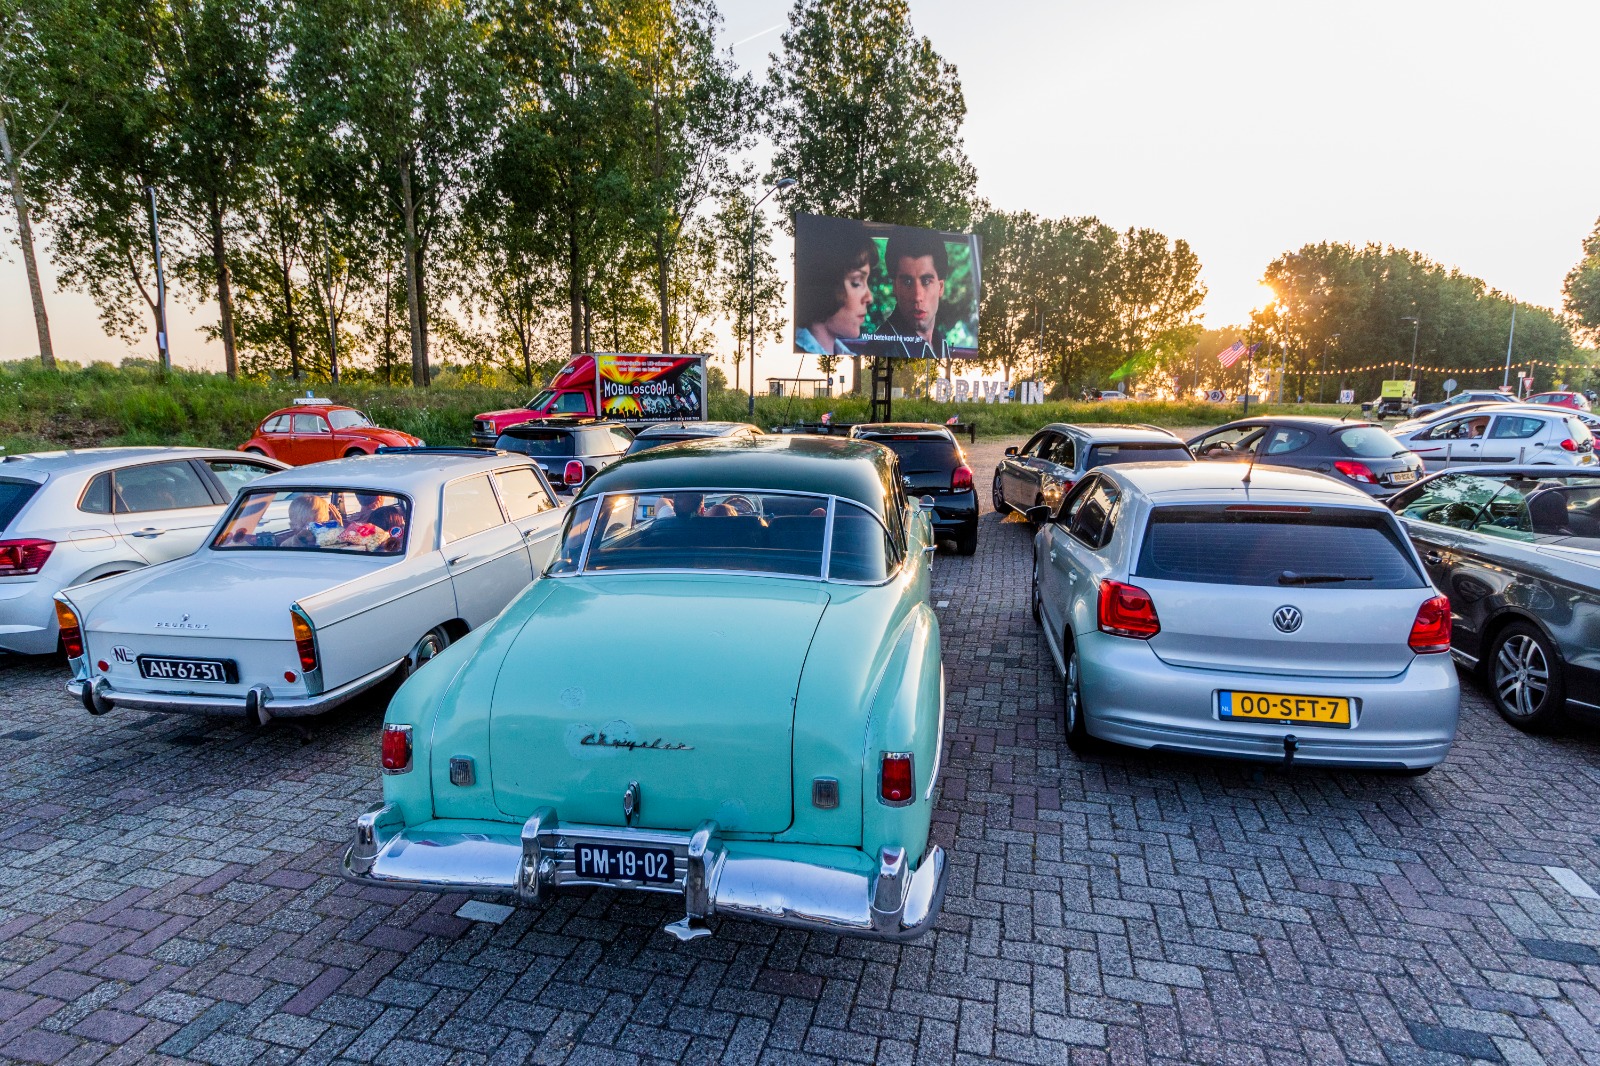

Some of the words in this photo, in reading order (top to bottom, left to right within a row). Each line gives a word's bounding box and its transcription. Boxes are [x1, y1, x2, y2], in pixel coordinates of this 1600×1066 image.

[873, 334, 896, 342] betekent
[935, 377, 1010, 404] DRIVE
[1021, 381, 1044, 405] IN
[113, 647, 134, 662] NL
[149, 660, 219, 681] AH-62-51
[1221, 705, 1231, 713] NL
[1240, 695, 1340, 720] 00-SFT-7
[580, 848, 669, 879] PM-19-02
